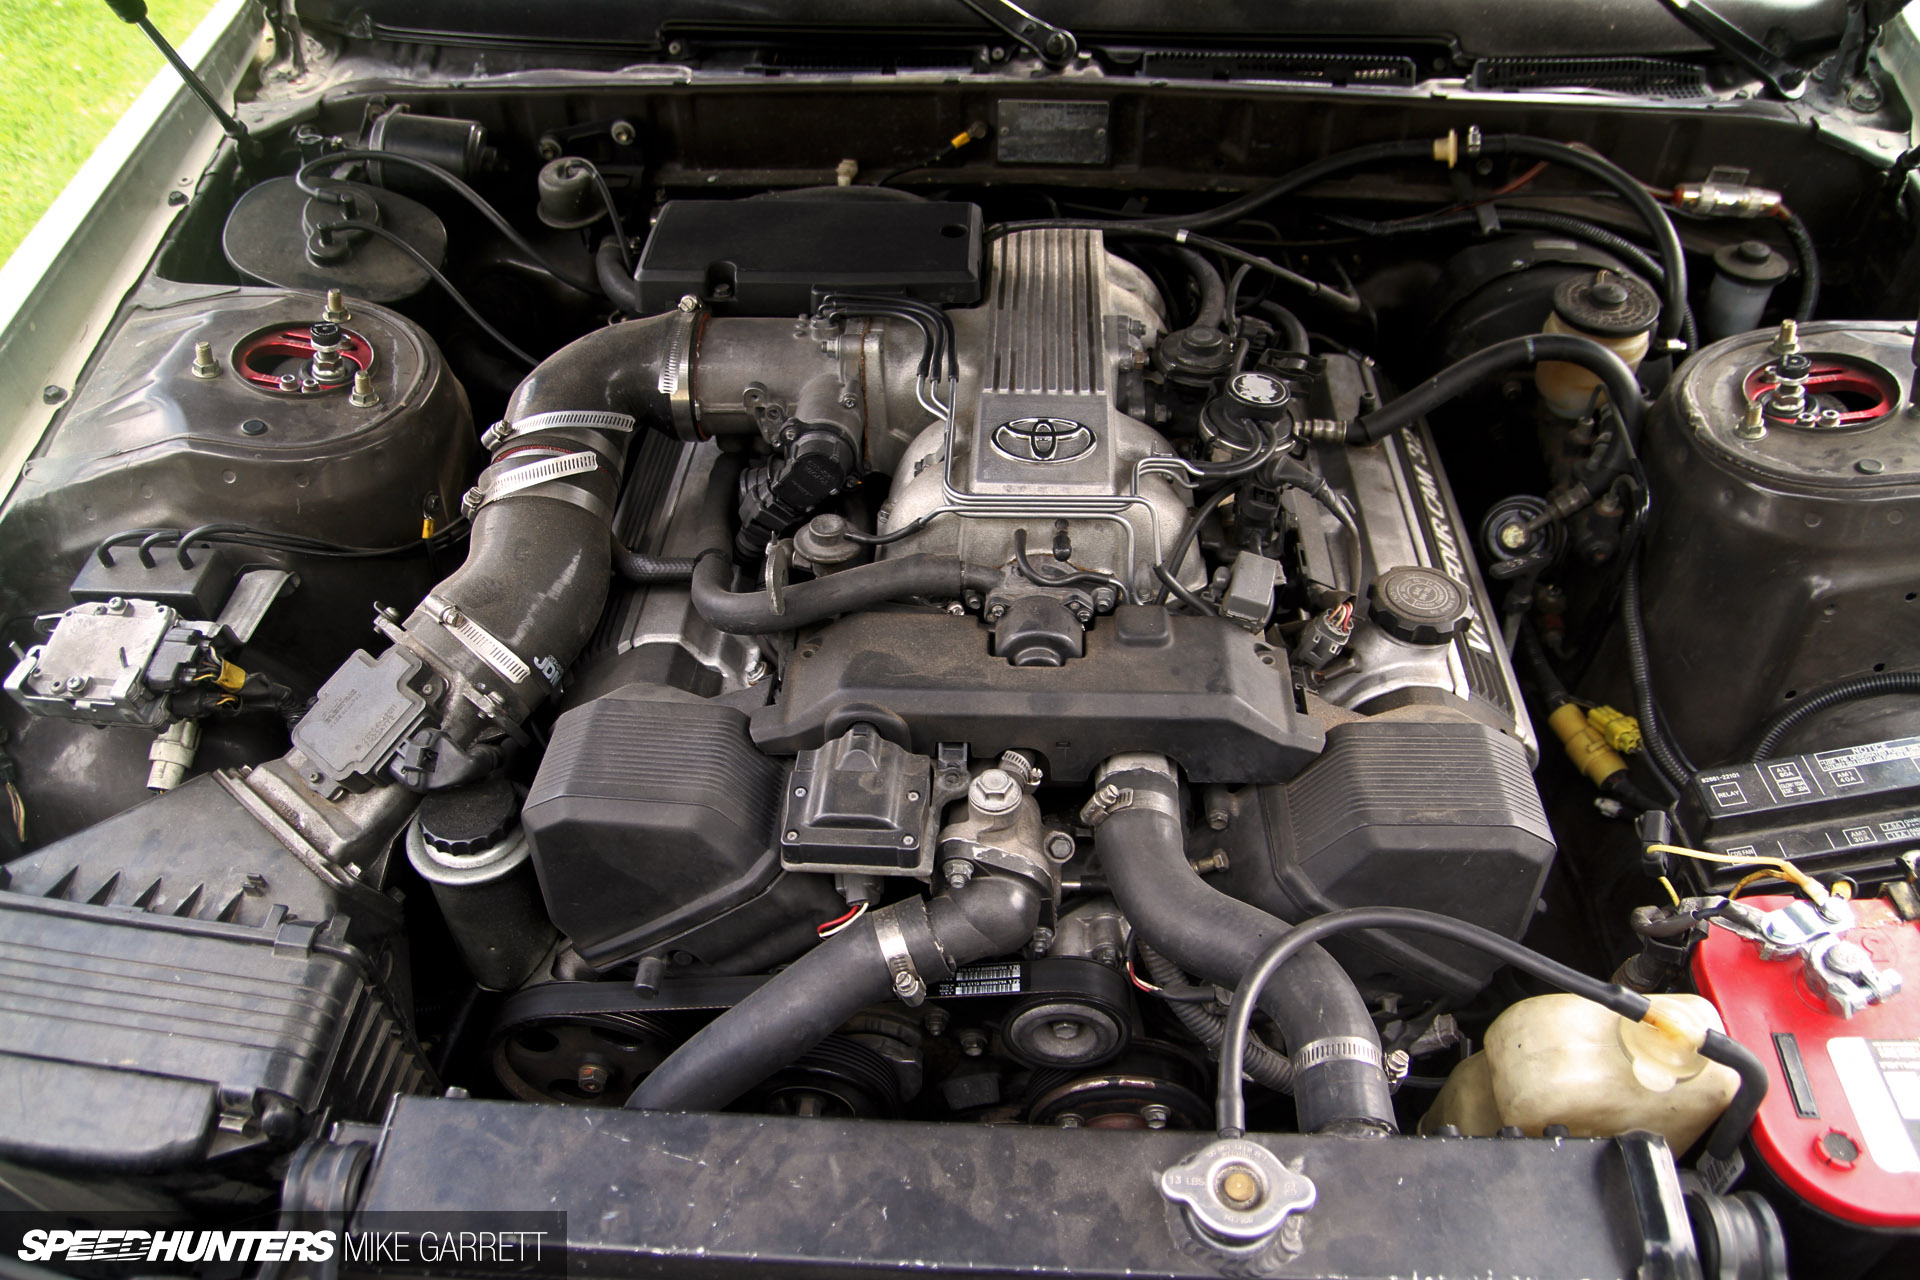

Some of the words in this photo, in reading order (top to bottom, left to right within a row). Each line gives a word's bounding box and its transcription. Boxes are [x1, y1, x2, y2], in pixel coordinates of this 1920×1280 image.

[1414, 464, 1446, 520] CAM
[1432, 519, 1466, 586] FOUR
[1853, 744, 1886, 755] NOTICE
[1717, 790, 1739, 799] RELAY
[1853, 835, 1871, 843] 30A
[1170, 1175, 1182, 1185] 13
